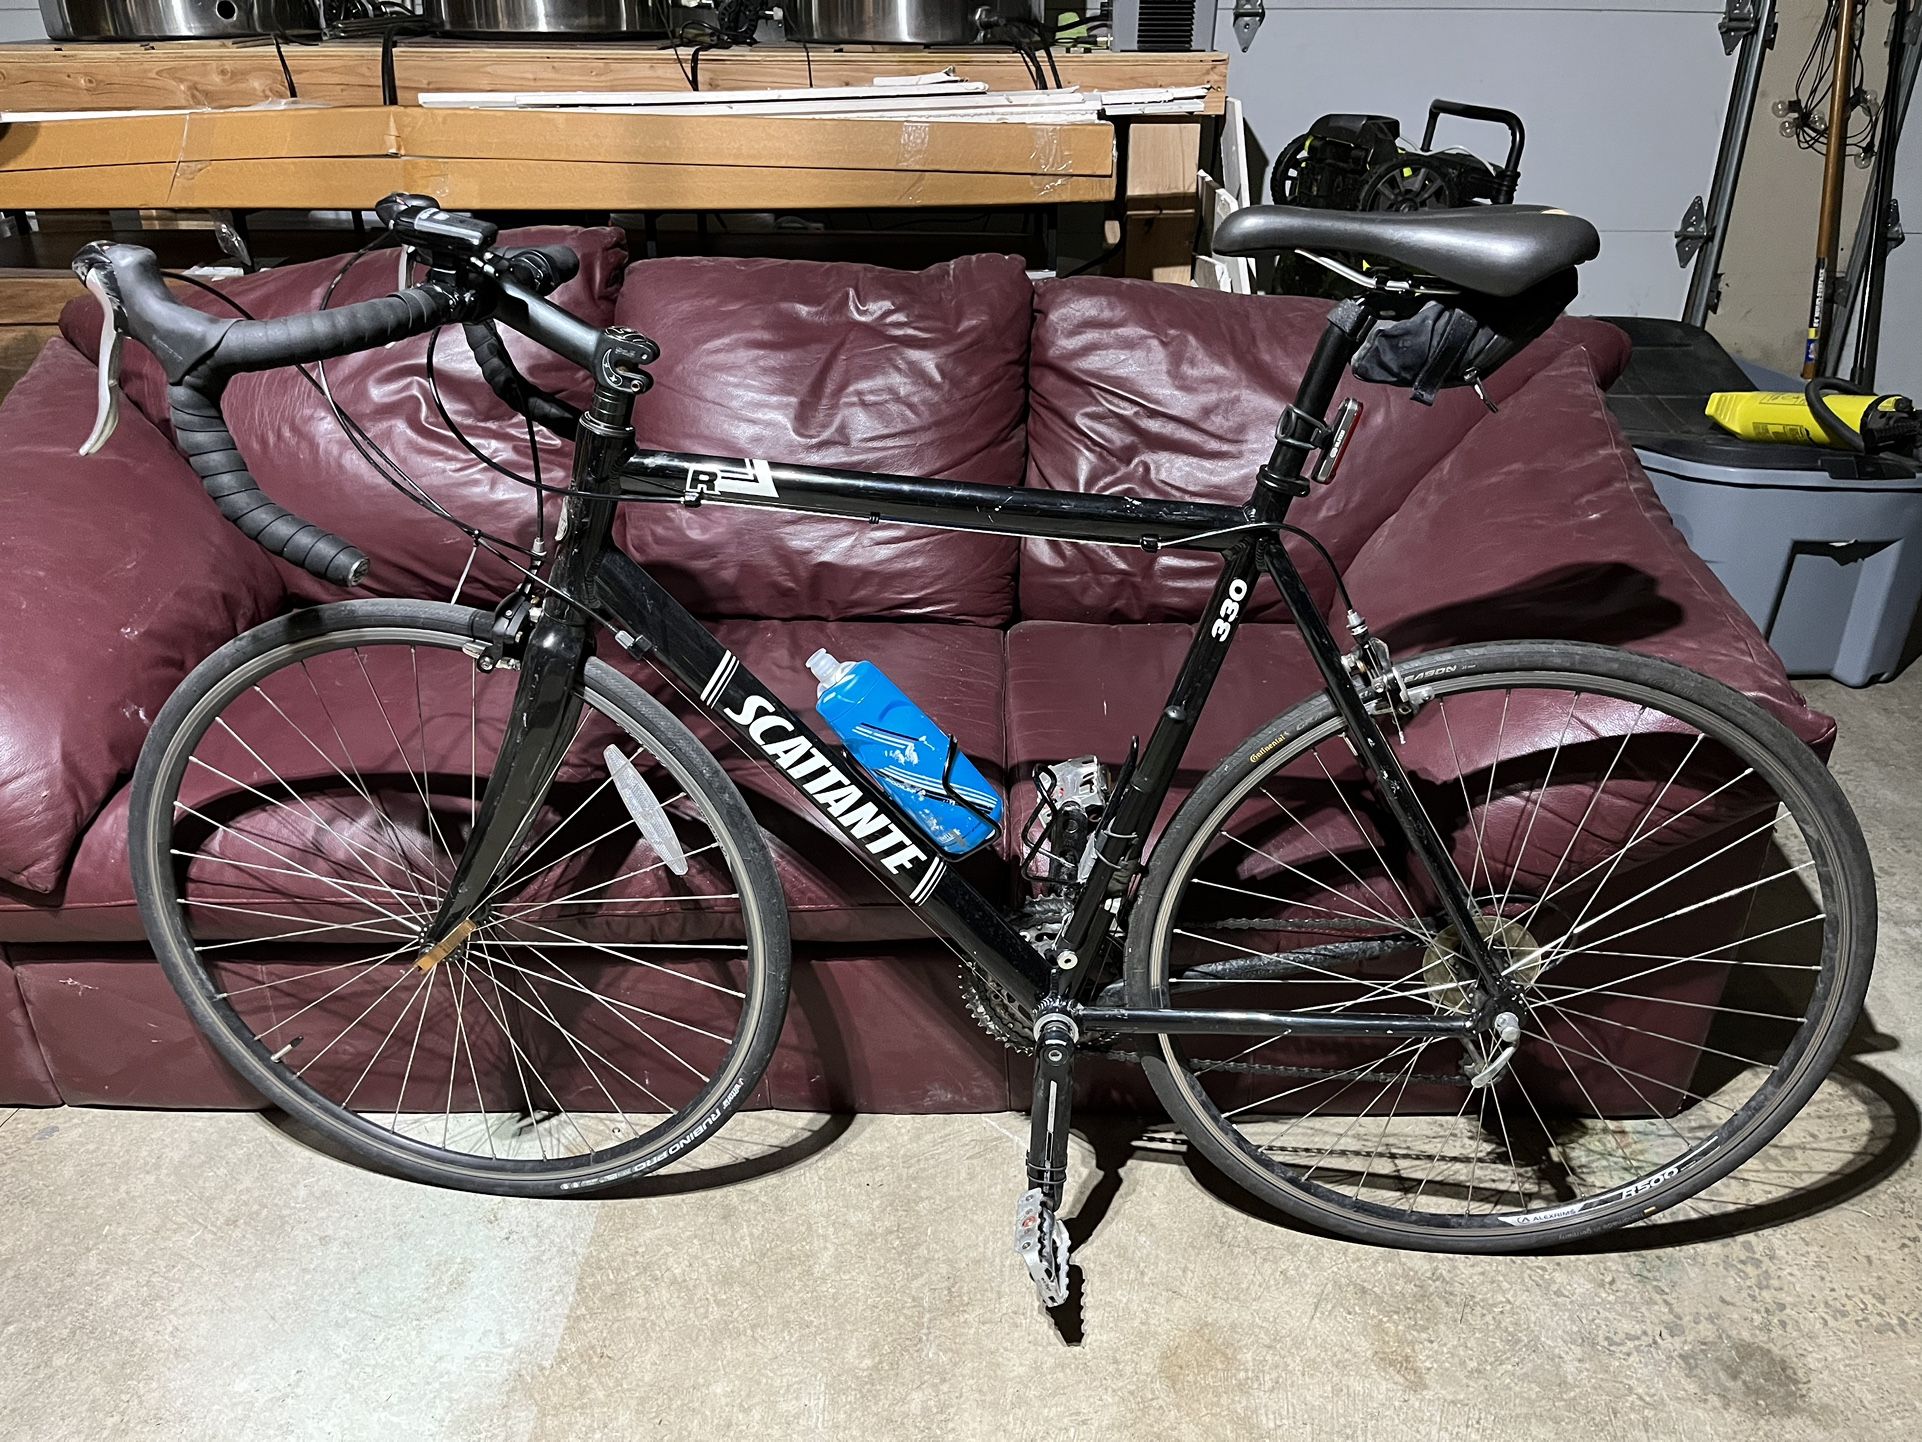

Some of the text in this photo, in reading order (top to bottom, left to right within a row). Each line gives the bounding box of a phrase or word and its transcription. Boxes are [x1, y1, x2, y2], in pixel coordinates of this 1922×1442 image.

[1211, 578, 1247, 642] 330
[1403, 664, 1457, 683] EASON
[723, 695, 928, 875] SCATTANTE
[669, 1110, 722, 1155] RUBINO
[632, 1150, 669, 1173] PRO
